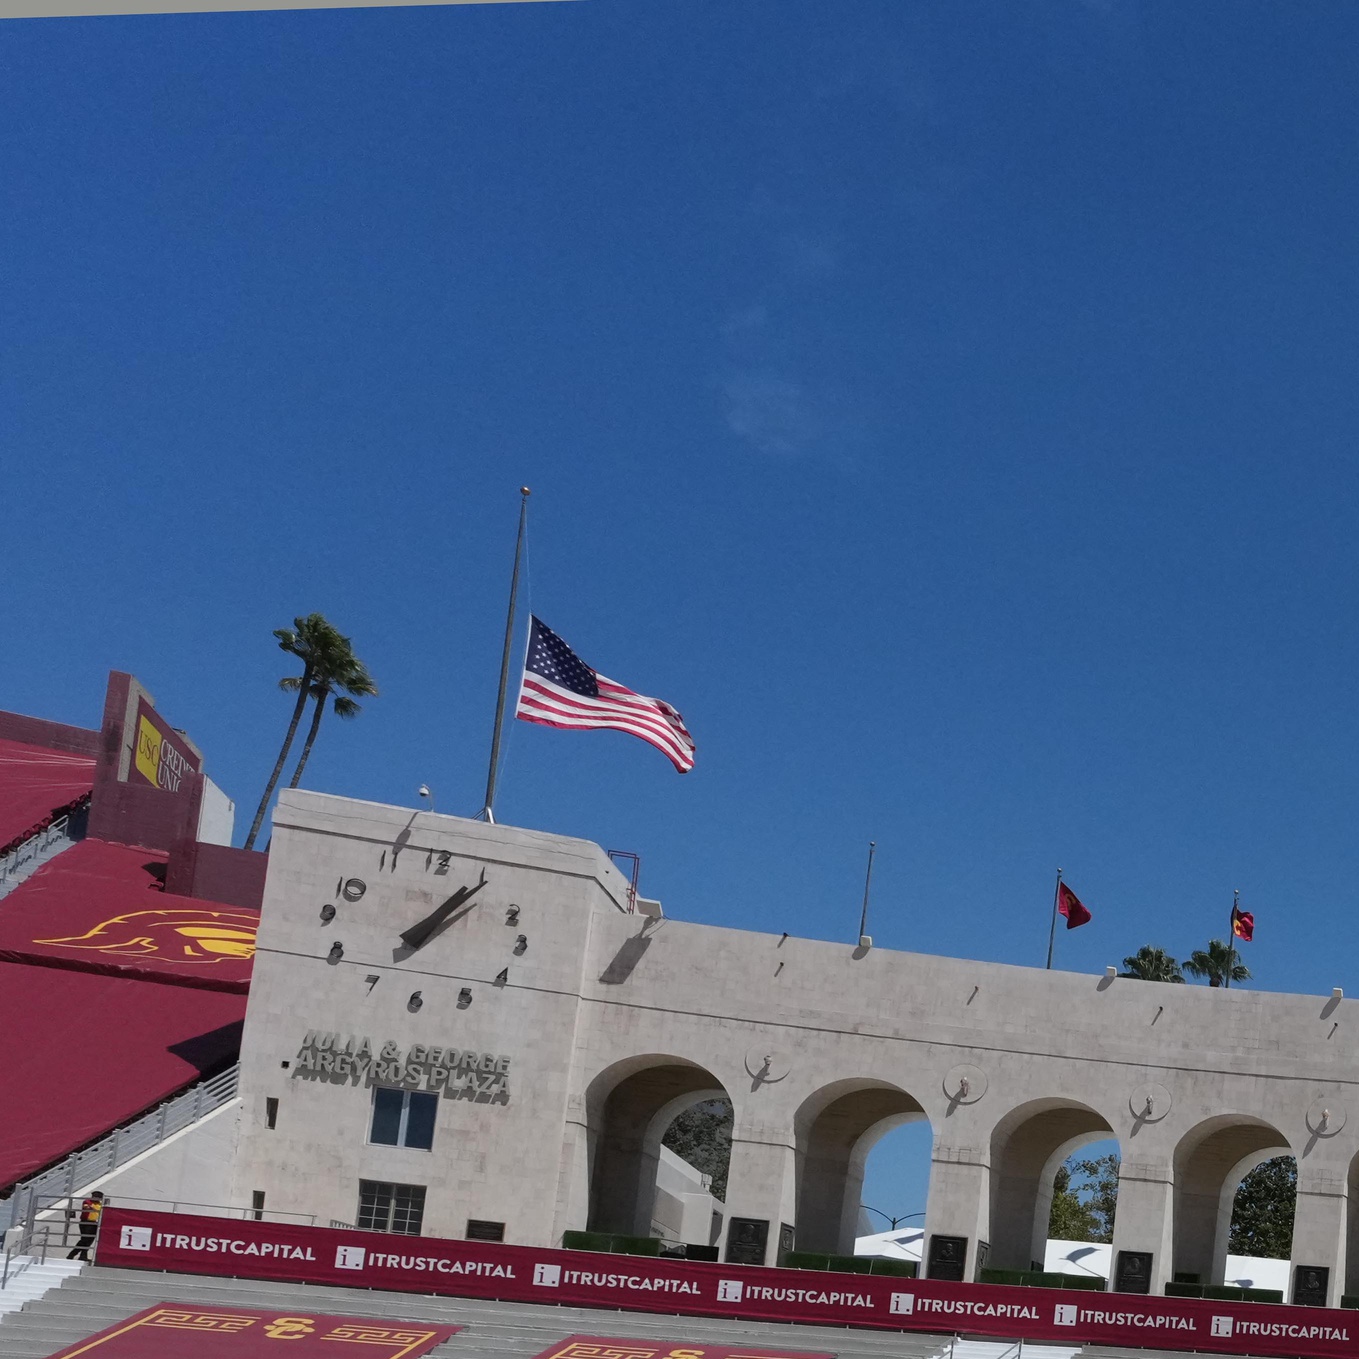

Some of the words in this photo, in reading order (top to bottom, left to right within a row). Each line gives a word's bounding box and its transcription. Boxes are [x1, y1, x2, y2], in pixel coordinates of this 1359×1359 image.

[138, 730, 159, 767] USC
[161, 739, 195, 778] CRE
[302, 1029, 372, 1056] JULIA
[381, 1039, 401, 1061] &
[409, 1043, 511, 1073] GEORGE
[297, 1050, 422, 1084] ARGYROS
[430, 1067, 511, 1094] PLAZA
[155, 1232, 317, 1261] ITRUSTCAPITAL
[368, 1252, 516, 1279] ITRUSTCAPITAL
[563, 1270, 702, 1295] ITRUSTCAPITAL
[745, 1285, 875, 1308] ITRUSTCAPITAL
[916, 1298, 1040, 1320] ITRUSTCAPITAL
[1079, 1309, 1197, 1331] ITRUSTCAPITAL
[1235, 1321, 1350, 1341] ITRUSTCAPITAL
